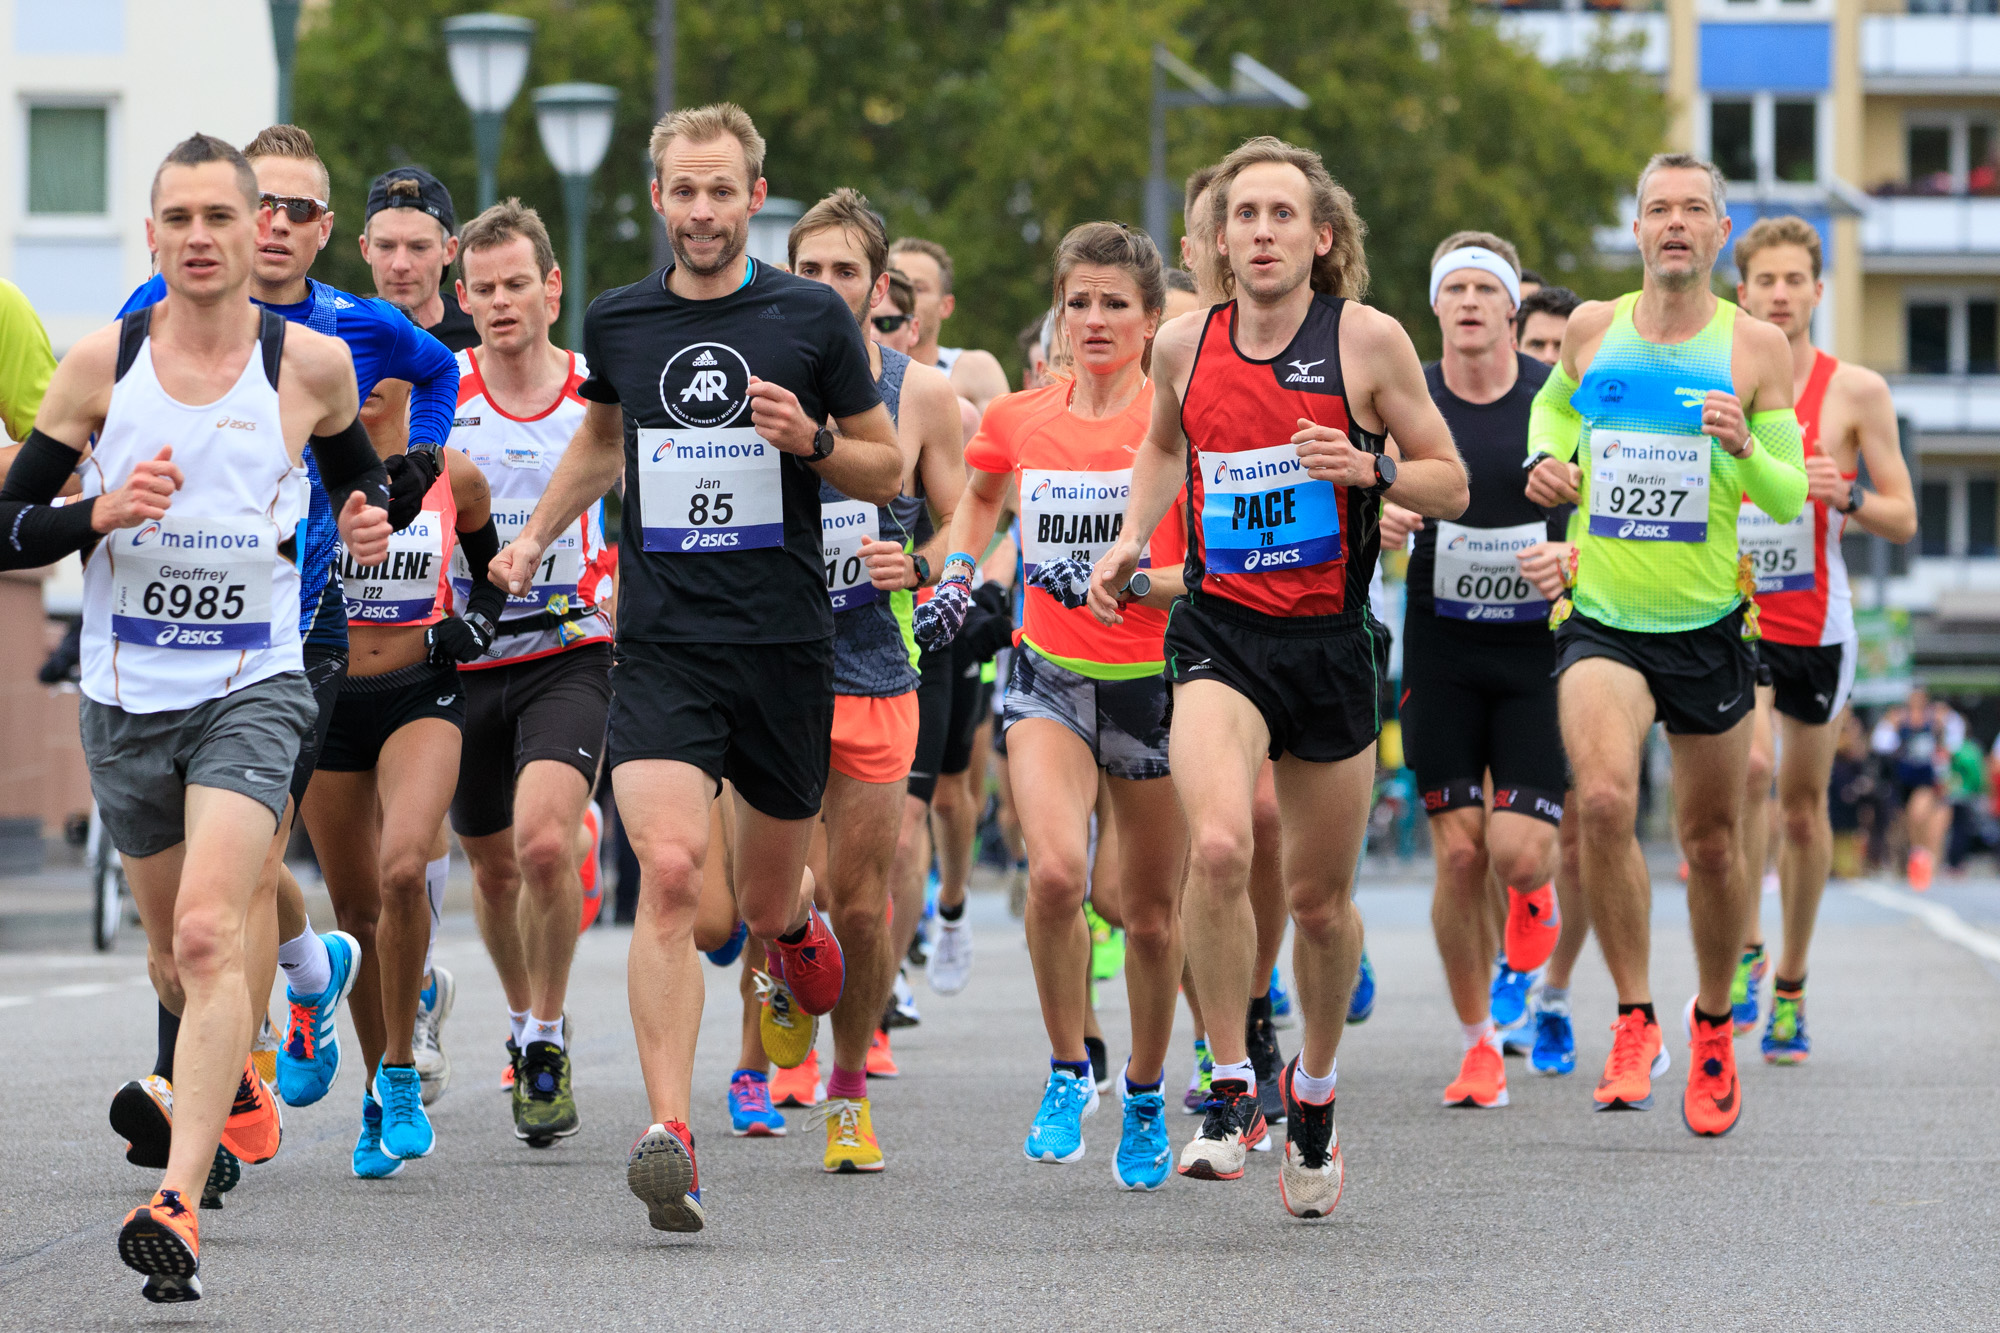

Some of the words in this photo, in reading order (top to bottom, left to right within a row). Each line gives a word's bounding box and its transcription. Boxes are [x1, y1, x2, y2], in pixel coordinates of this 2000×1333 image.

[679, 370, 729, 402] AR
[671, 403, 690, 420] ADIDAS
[690, 416, 717, 424] RUNNERS
[720, 400, 740, 419] MUNICH
[229, 419, 257, 431] asics
[676, 441, 765, 459] mainova
[1622, 444, 1698, 462] mainova
[1229, 456, 1309, 482] mainov
[695, 477, 721, 489] Jan
[1627, 473, 1666, 485] Martin
[1052, 483, 1129, 500] mainova
[688, 493, 734, 526] 85
[1232, 487, 1296, 531] PACE
[1609, 486, 1689, 518] 9237
[1037, 513, 1124, 544] BOJANA
[1634, 524, 1670, 538] asics
[160, 530, 260, 549] mainova
[699, 532, 739, 547] asics
[1260, 531, 1274, 547] 78
[1468, 537, 1537, 552] mainova
[1071, 550, 1090, 562] F24
[1261, 548, 1300, 566] asics
[159, 565, 229, 583] Geoffrey
[363, 586, 383, 599] F22
[1456, 574, 1530, 601] 6006
[143, 581, 246, 620] 6985
[362, 605, 399, 619] asics
[1482, 606, 1515, 619] asics
[176, 629, 223, 645] asics
